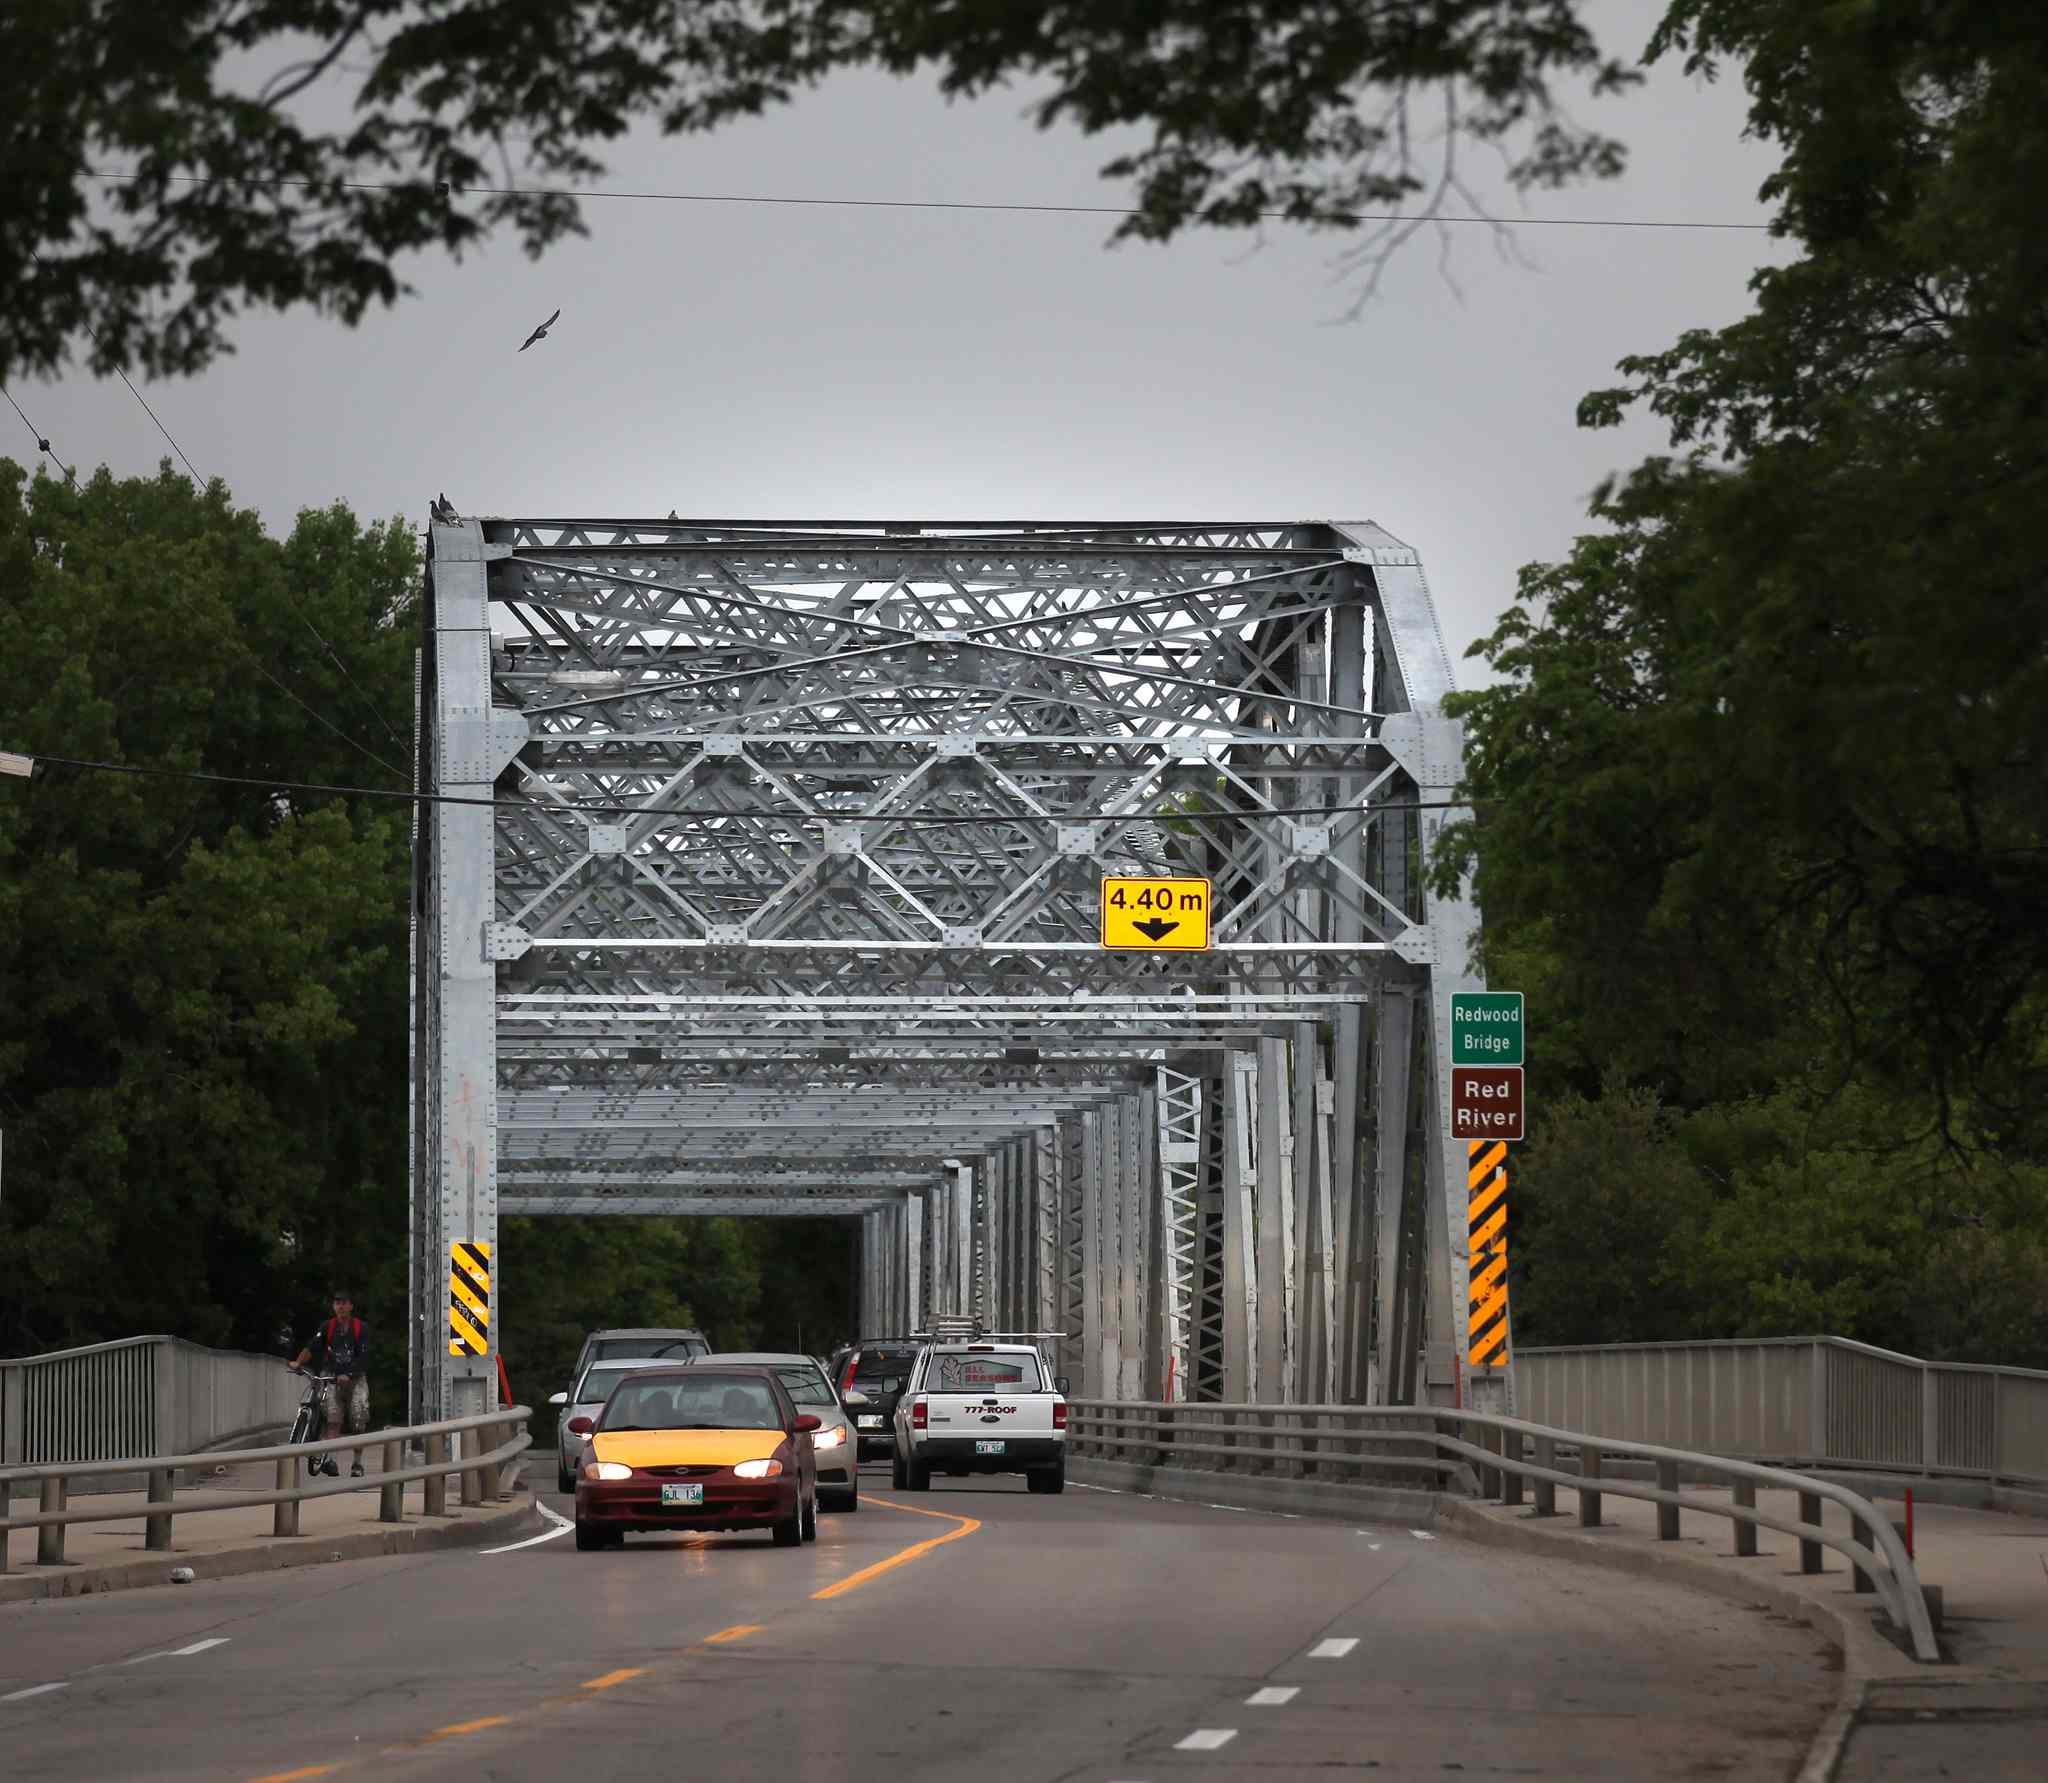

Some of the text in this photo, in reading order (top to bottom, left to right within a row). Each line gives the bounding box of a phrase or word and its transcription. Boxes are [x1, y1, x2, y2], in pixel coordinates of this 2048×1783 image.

[1110, 888, 1202, 911] 4.40 m
[1455, 1006, 1519, 1022] Redwood
[1464, 1034, 1511, 1053] Bridge
[1465, 1080, 1509, 1098] Red
[1457, 1108, 1517, 1127] River
[963, 1406, 1017, 1414] 777-ROOF
